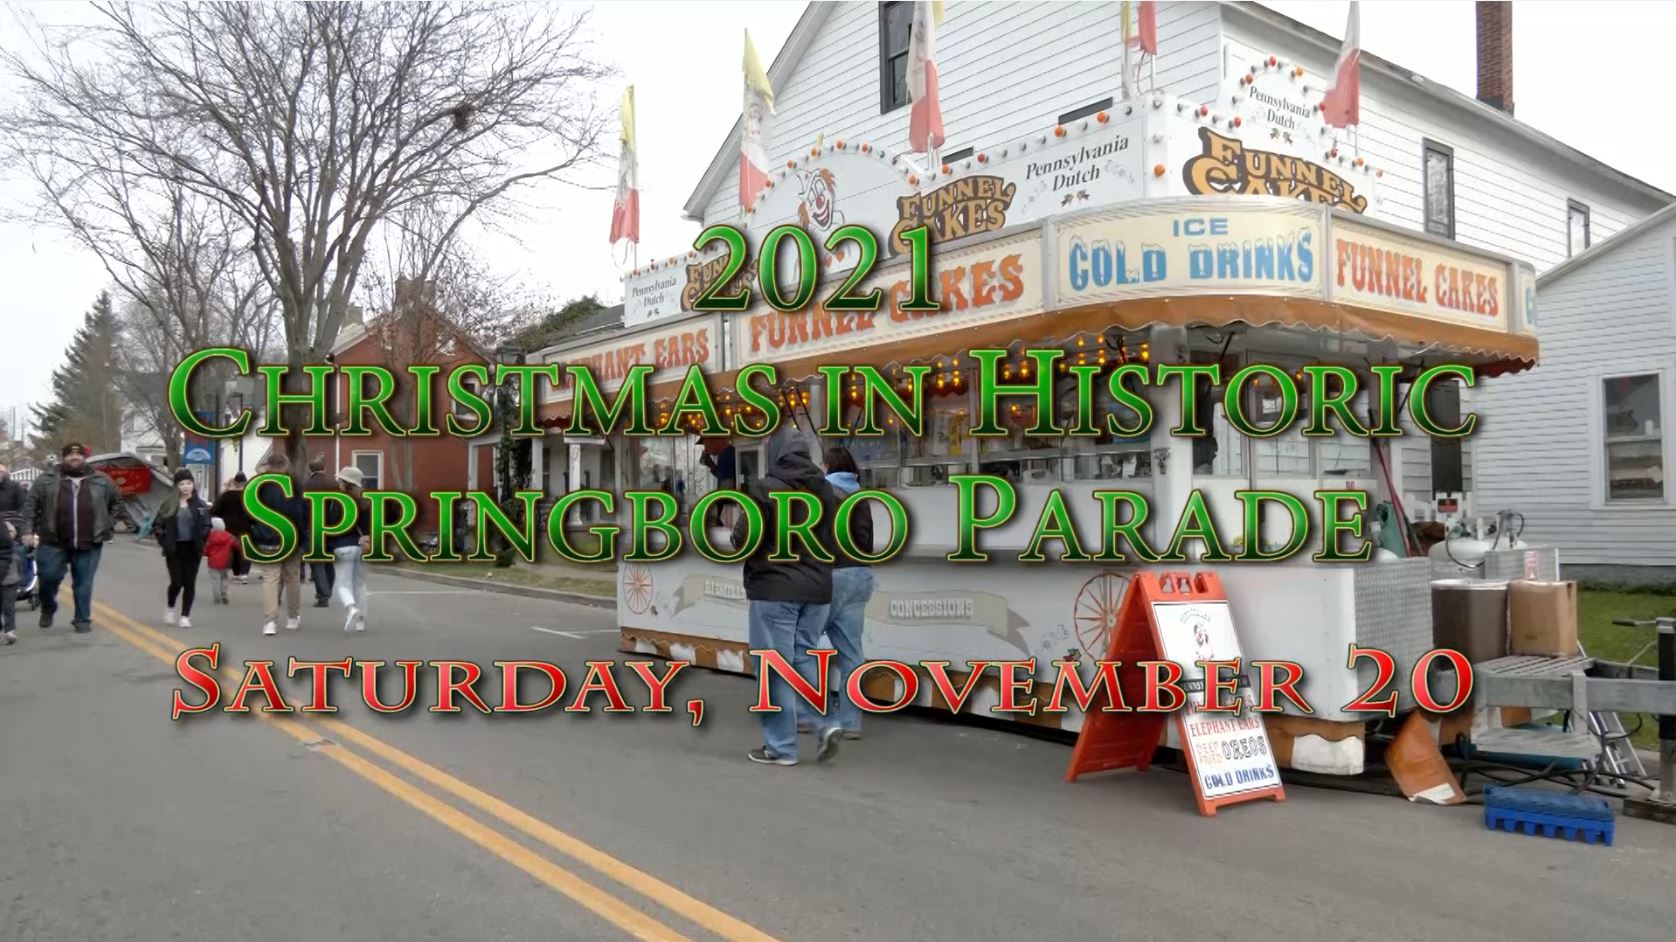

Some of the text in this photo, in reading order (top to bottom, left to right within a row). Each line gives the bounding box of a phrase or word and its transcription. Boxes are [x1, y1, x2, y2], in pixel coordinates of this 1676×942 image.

[1250, 86, 1310, 119] Pennsylvania
[1267, 108, 1295, 130] Dutch
[1025, 134, 1130, 180] Pennsylvania
[1198, 126, 1368, 214] FUNNEL
[1051, 165, 1101, 192] Dutch
[896, 175, 1017, 219] FUNNEL
[1172, 217, 1230, 238] ICE
[1068, 226, 1314, 292] COLD DRINKS
[631, 276, 678, 298] Pennsylvania
[1335, 238, 1428, 304] FUNNEL
[1434, 262, 1500, 318] CAKES
[643, 294, 665, 308] Dutch
[654, 327, 710, 369] EARS
[889, 599, 974, 620] CONCESSIONS
[1190, 719, 1238, 737] ELEPHANT
[1204, 764, 1275, 790] COLD DRINKS
